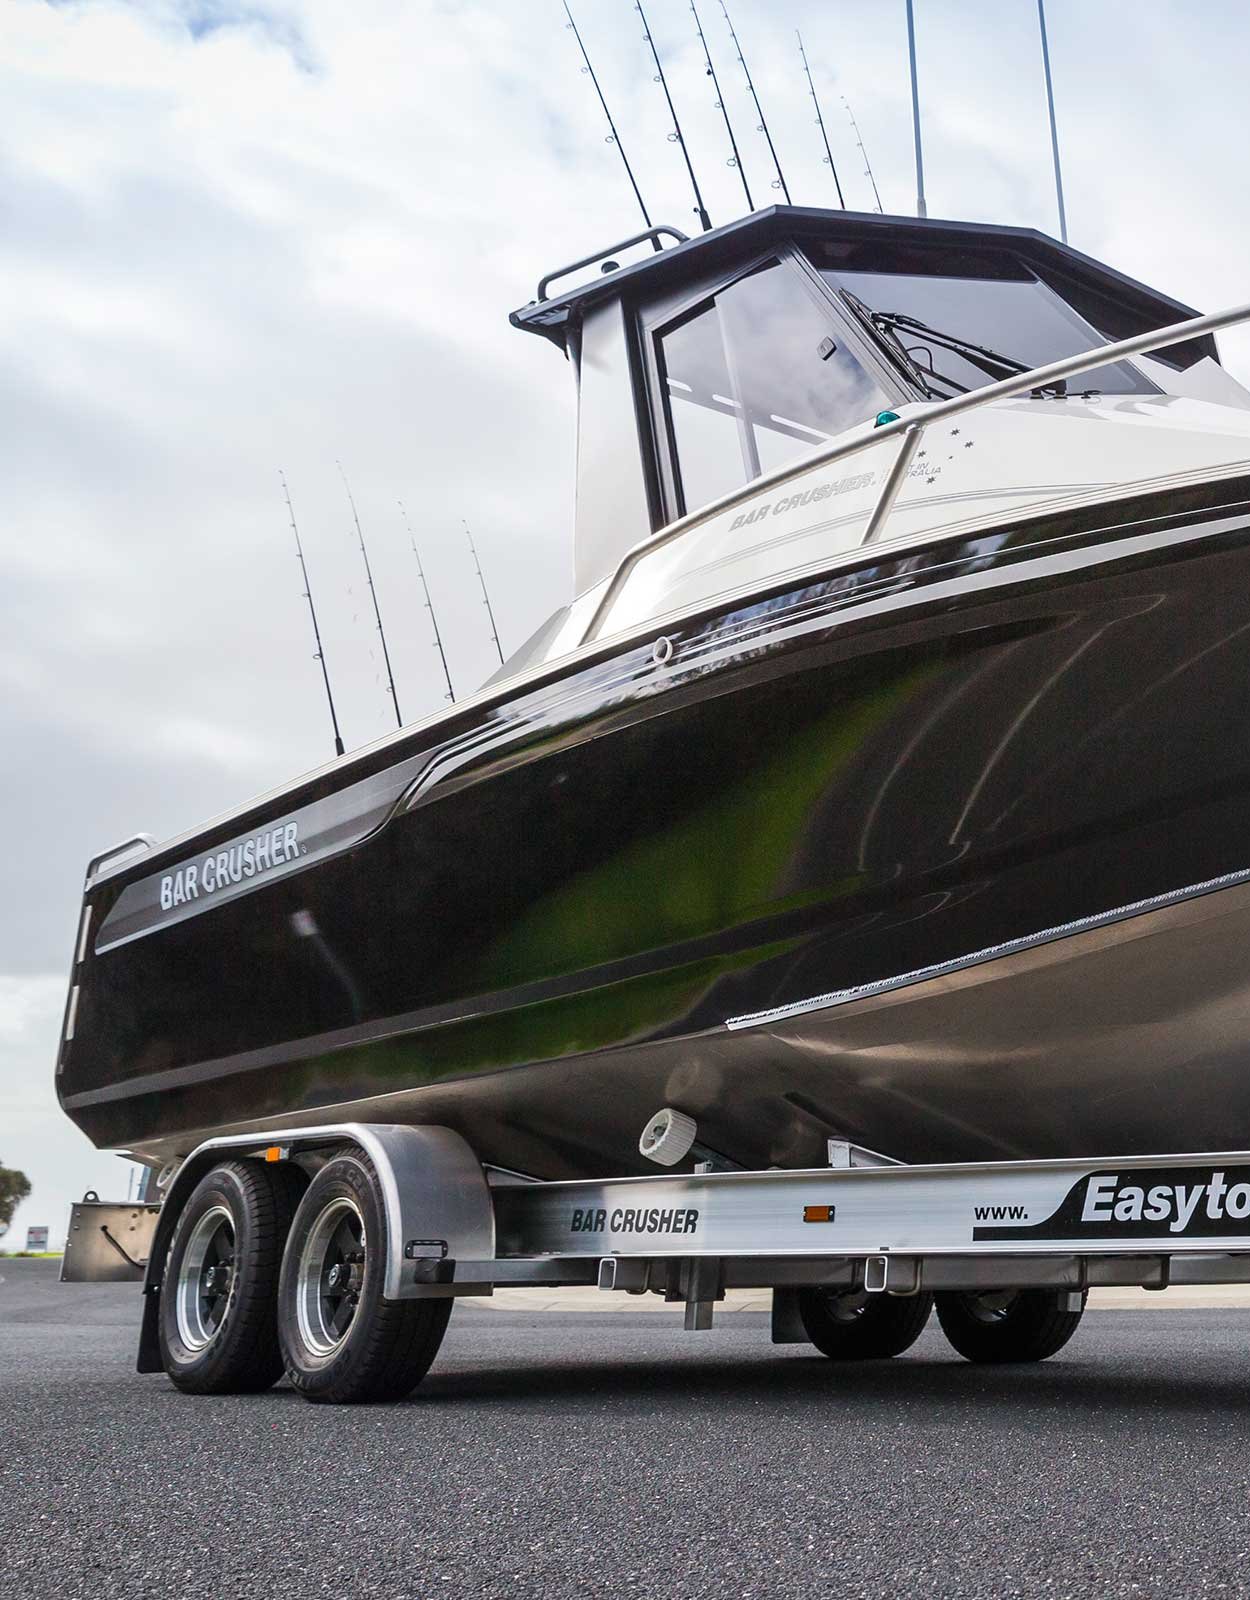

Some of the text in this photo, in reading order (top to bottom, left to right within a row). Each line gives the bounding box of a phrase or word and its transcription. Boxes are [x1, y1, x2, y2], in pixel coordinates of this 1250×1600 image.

[728, 471, 875, 532] BAR CRUSHER
[160, 821, 300, 911] BAR CRUSHER
[570, 1208, 699, 1234] BAR CRUSHER
[975, 1206, 1028, 1220] www.
